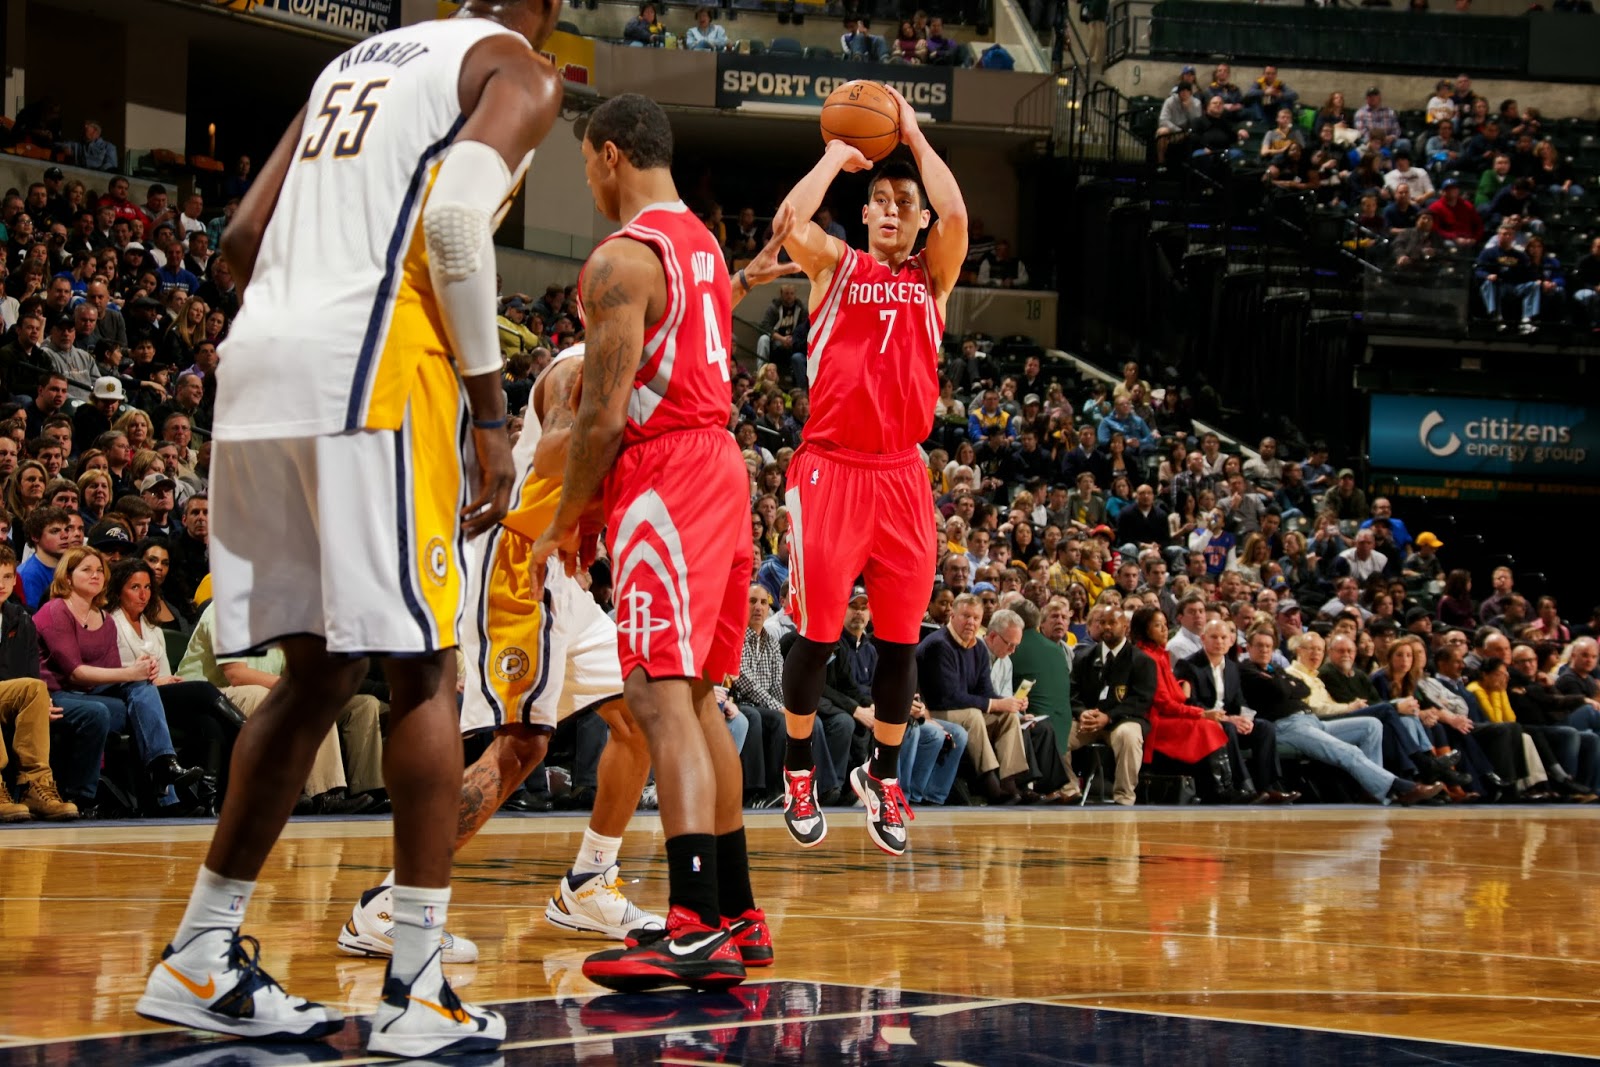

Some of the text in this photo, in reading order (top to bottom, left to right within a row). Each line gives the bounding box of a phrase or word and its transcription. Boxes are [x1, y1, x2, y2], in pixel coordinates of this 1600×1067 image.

[723, 70, 947, 105] SPORT GHICS
[1133, 65, 1141, 86] 9
[299, 77, 391, 161] 55
[847, 281, 926, 305] ROCKETS
[702, 293, 730, 383] 4
[879, 309, 898, 354] 7
[1464, 417, 1571, 443] citizens
[1465, 443, 1586, 464] energy group
